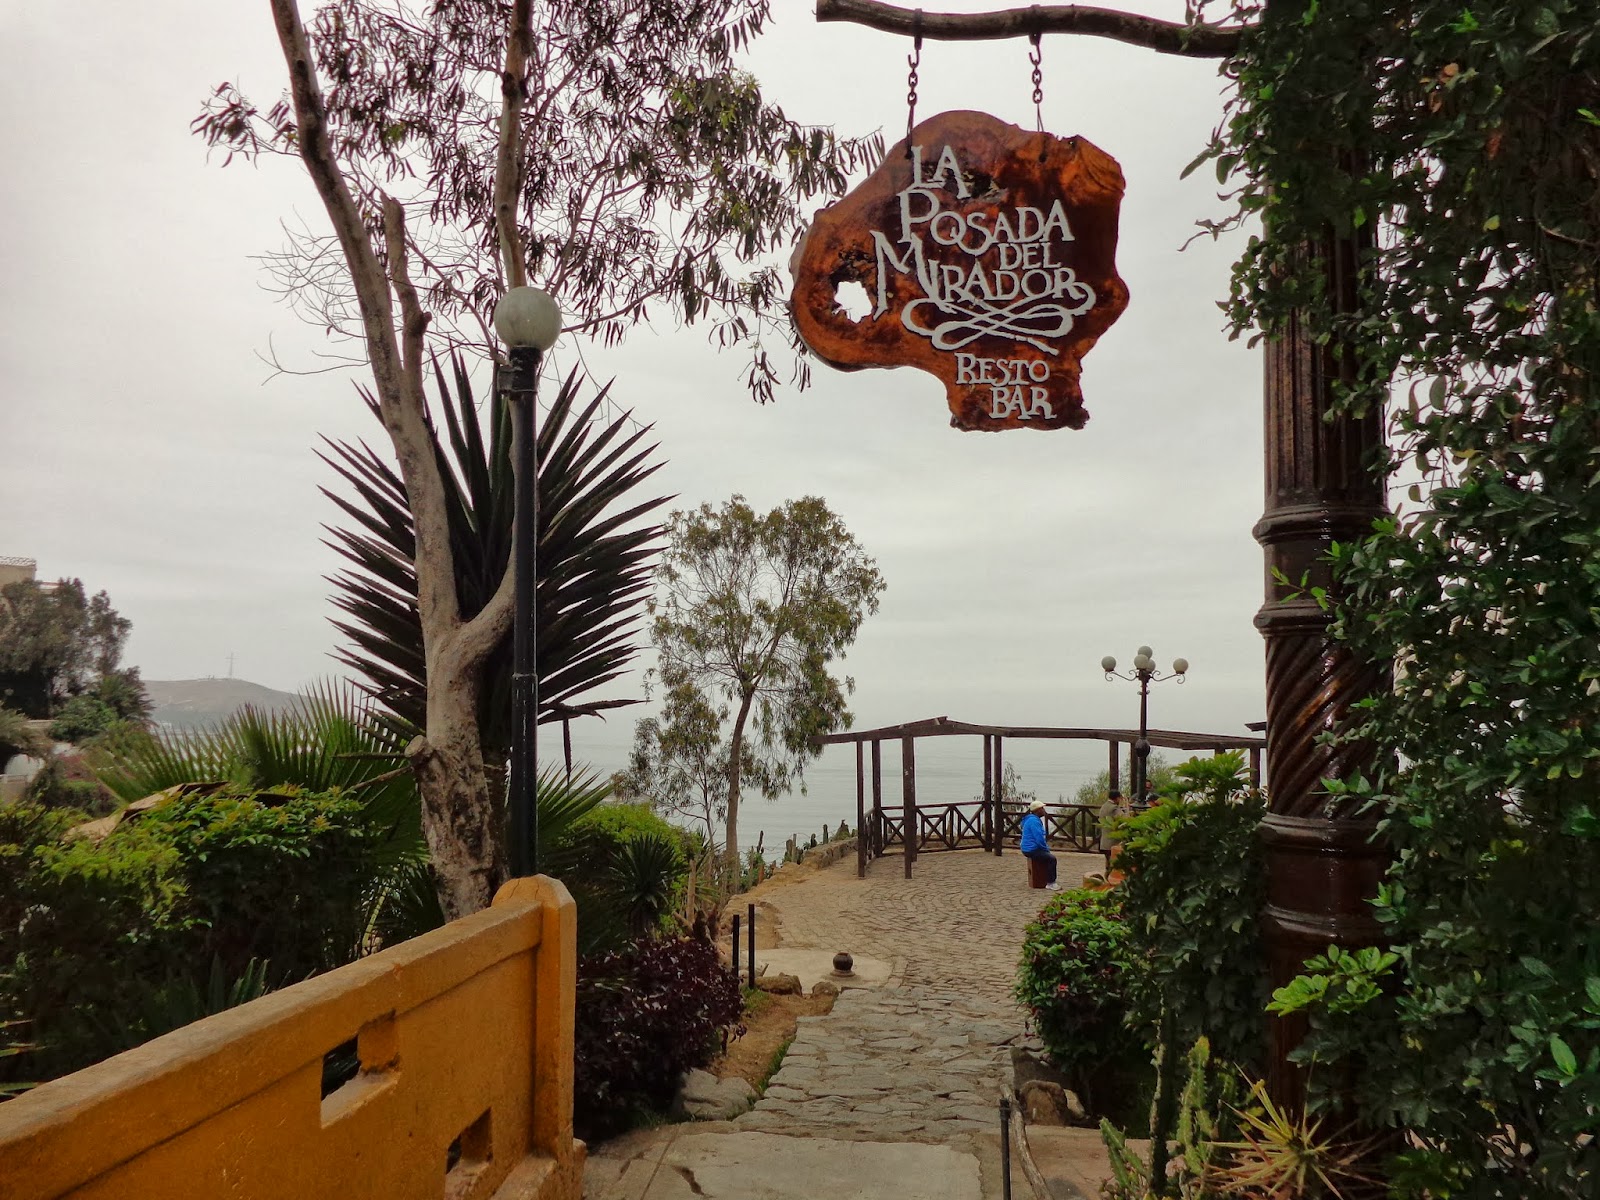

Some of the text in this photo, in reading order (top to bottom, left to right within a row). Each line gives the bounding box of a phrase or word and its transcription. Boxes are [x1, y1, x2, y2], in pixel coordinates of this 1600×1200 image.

[909, 145, 971, 200] LA
[897, 188, 1075, 256] POSADA
[869, 230, 1096, 321] MIRADOR
[999, 243, 1063, 270] DEL
[954, 352, 1050, 386] RESTO
[988, 387, 1057, 420] BAR
